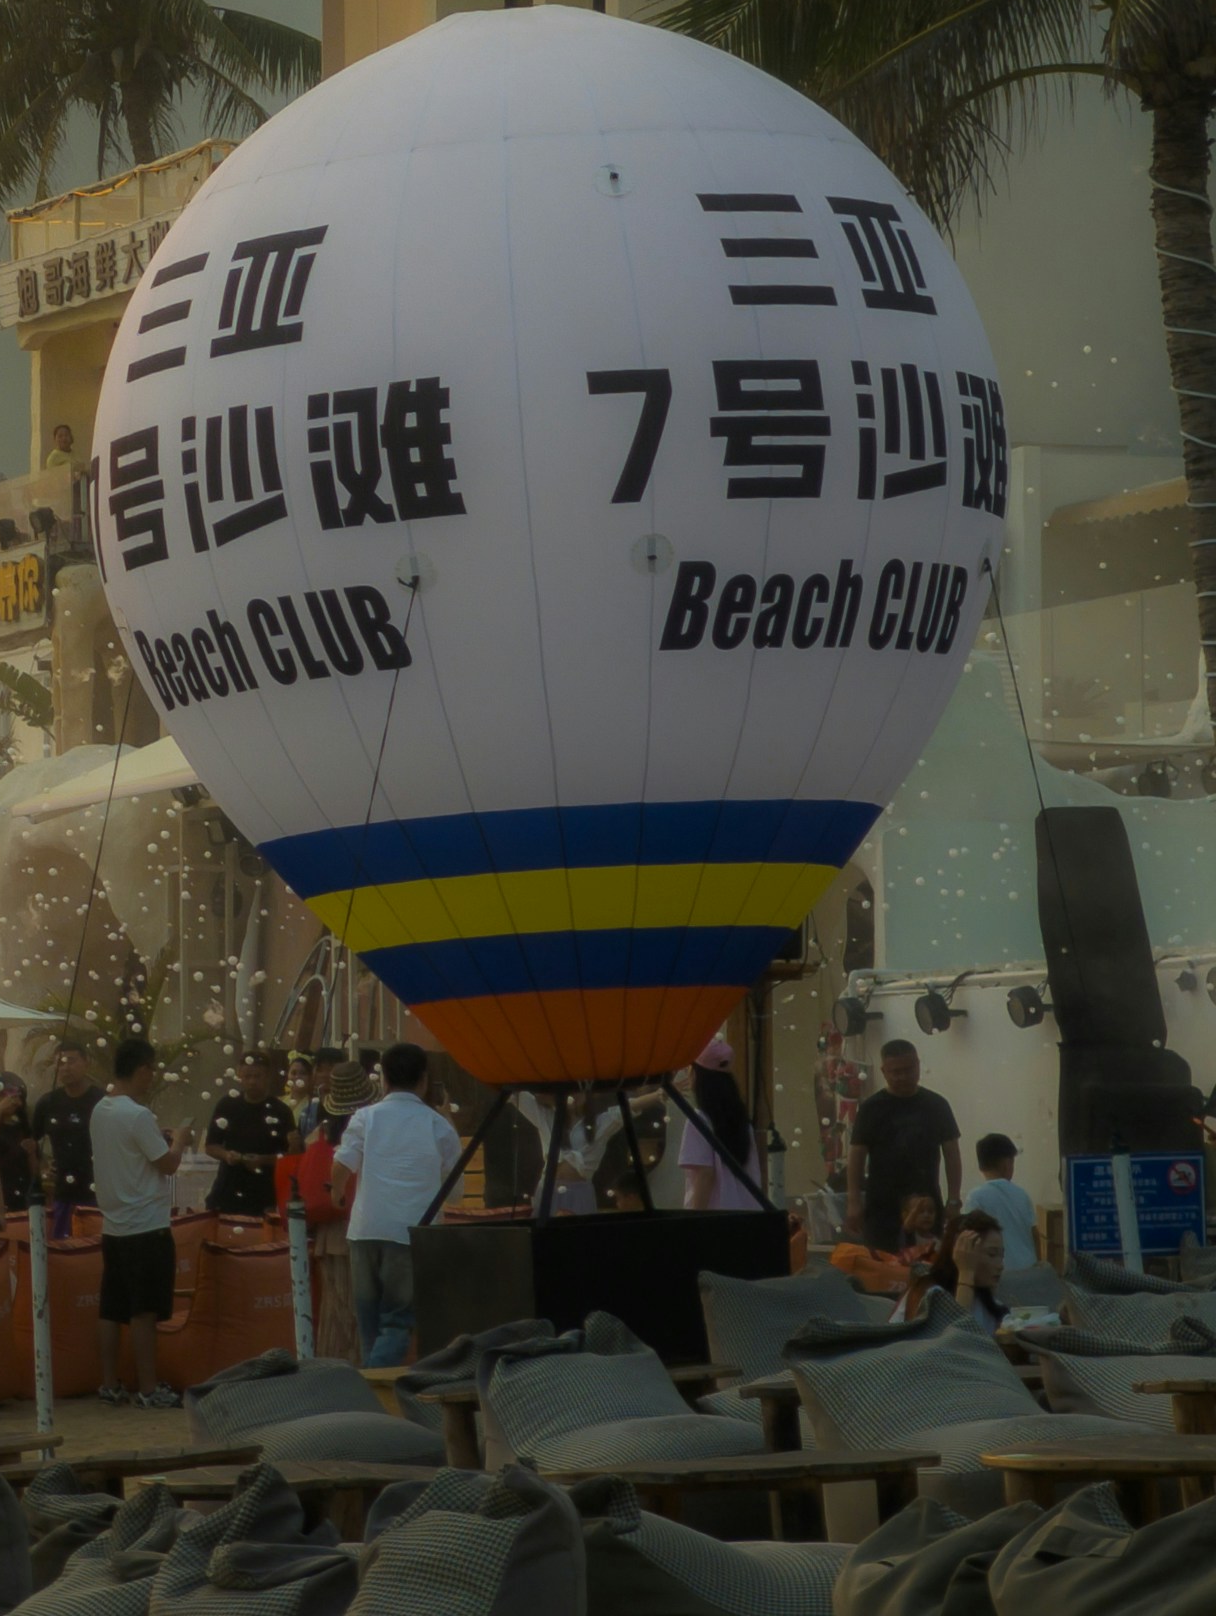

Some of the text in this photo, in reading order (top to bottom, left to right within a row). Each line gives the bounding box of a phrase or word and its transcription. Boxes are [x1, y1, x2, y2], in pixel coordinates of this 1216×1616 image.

[126, 224, 330, 383] 三亚
[695, 192, 938, 317] 三亚
[585, 358, 1008, 520] 7号沙滩
[133, 584, 413, 712] Beach CLUB
[659, 558, 968, 655] Beach CLUB
